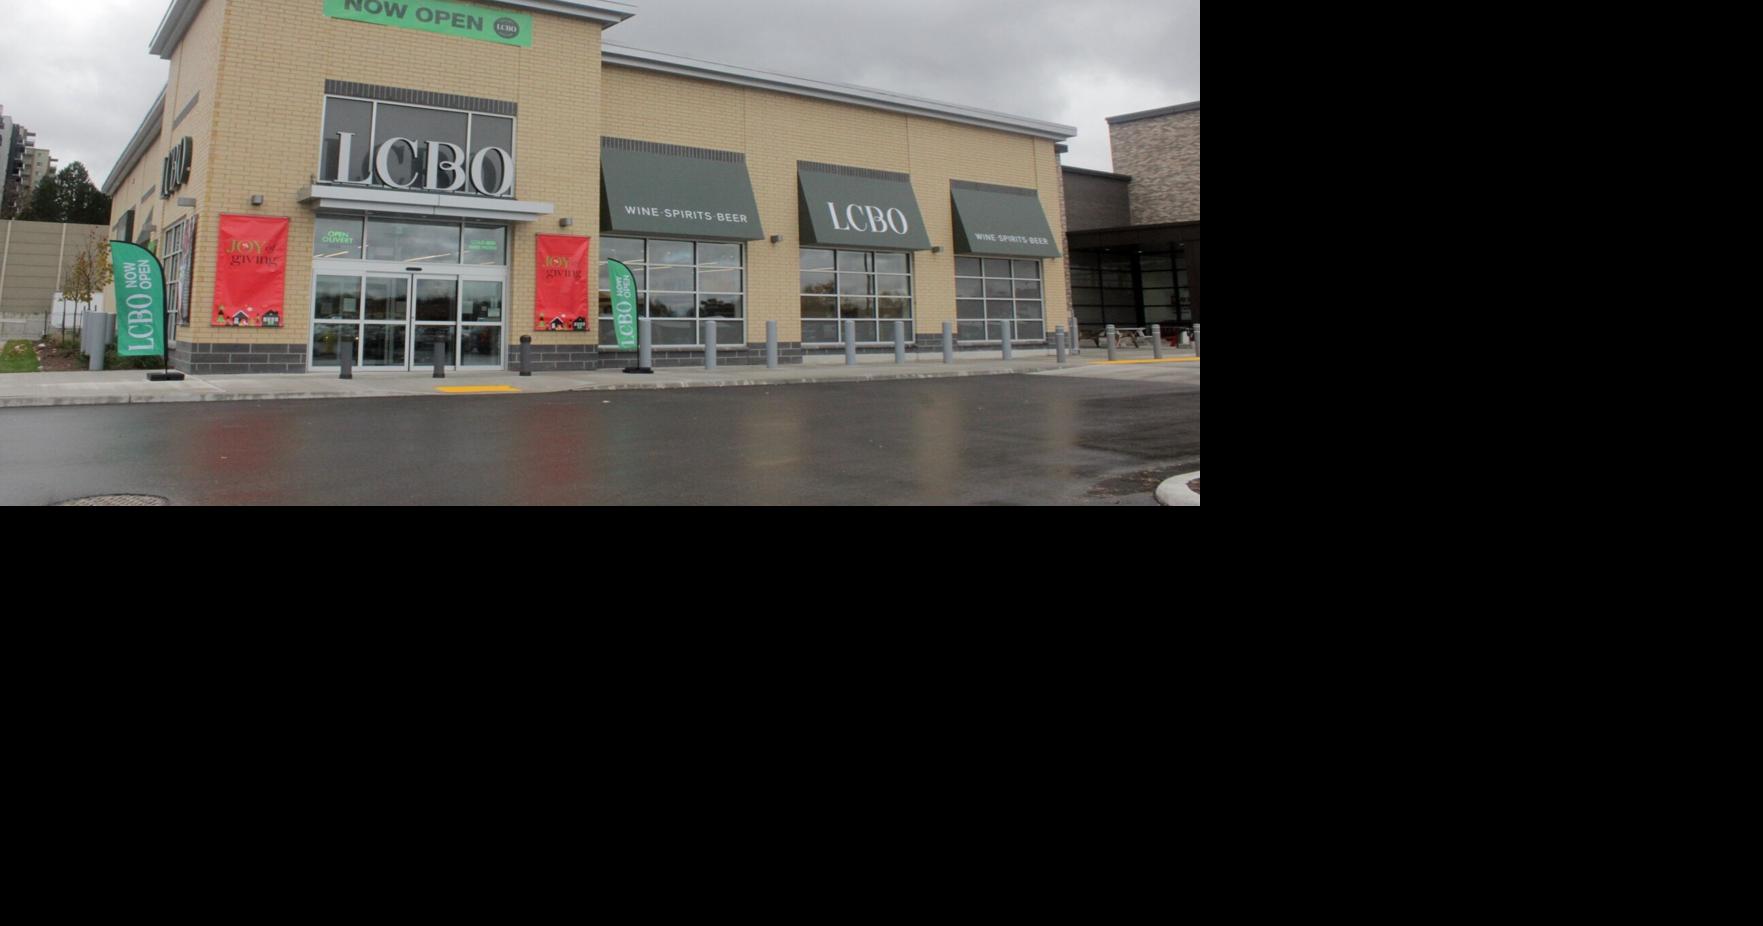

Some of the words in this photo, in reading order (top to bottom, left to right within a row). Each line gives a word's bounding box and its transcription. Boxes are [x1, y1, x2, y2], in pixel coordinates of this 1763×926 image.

[344, 0, 408, 19] NOW
[415, 7, 484, 31] OPEN
[334, 131, 514, 197] LCBO
[624, 205, 660, 217] WINE
[663, 208, 713, 221] SPIRITS
[716, 212, 748, 223] BEER
[827, 201, 909, 235] LCBO
[225, 240, 264, 255] JOY
[230, 255, 278, 266] giving
[124, 262, 137, 289] NOW
[138, 259, 152, 290] OPEN
[126, 294, 154, 351] LCBO
[615, 301, 635, 346] LCBO
